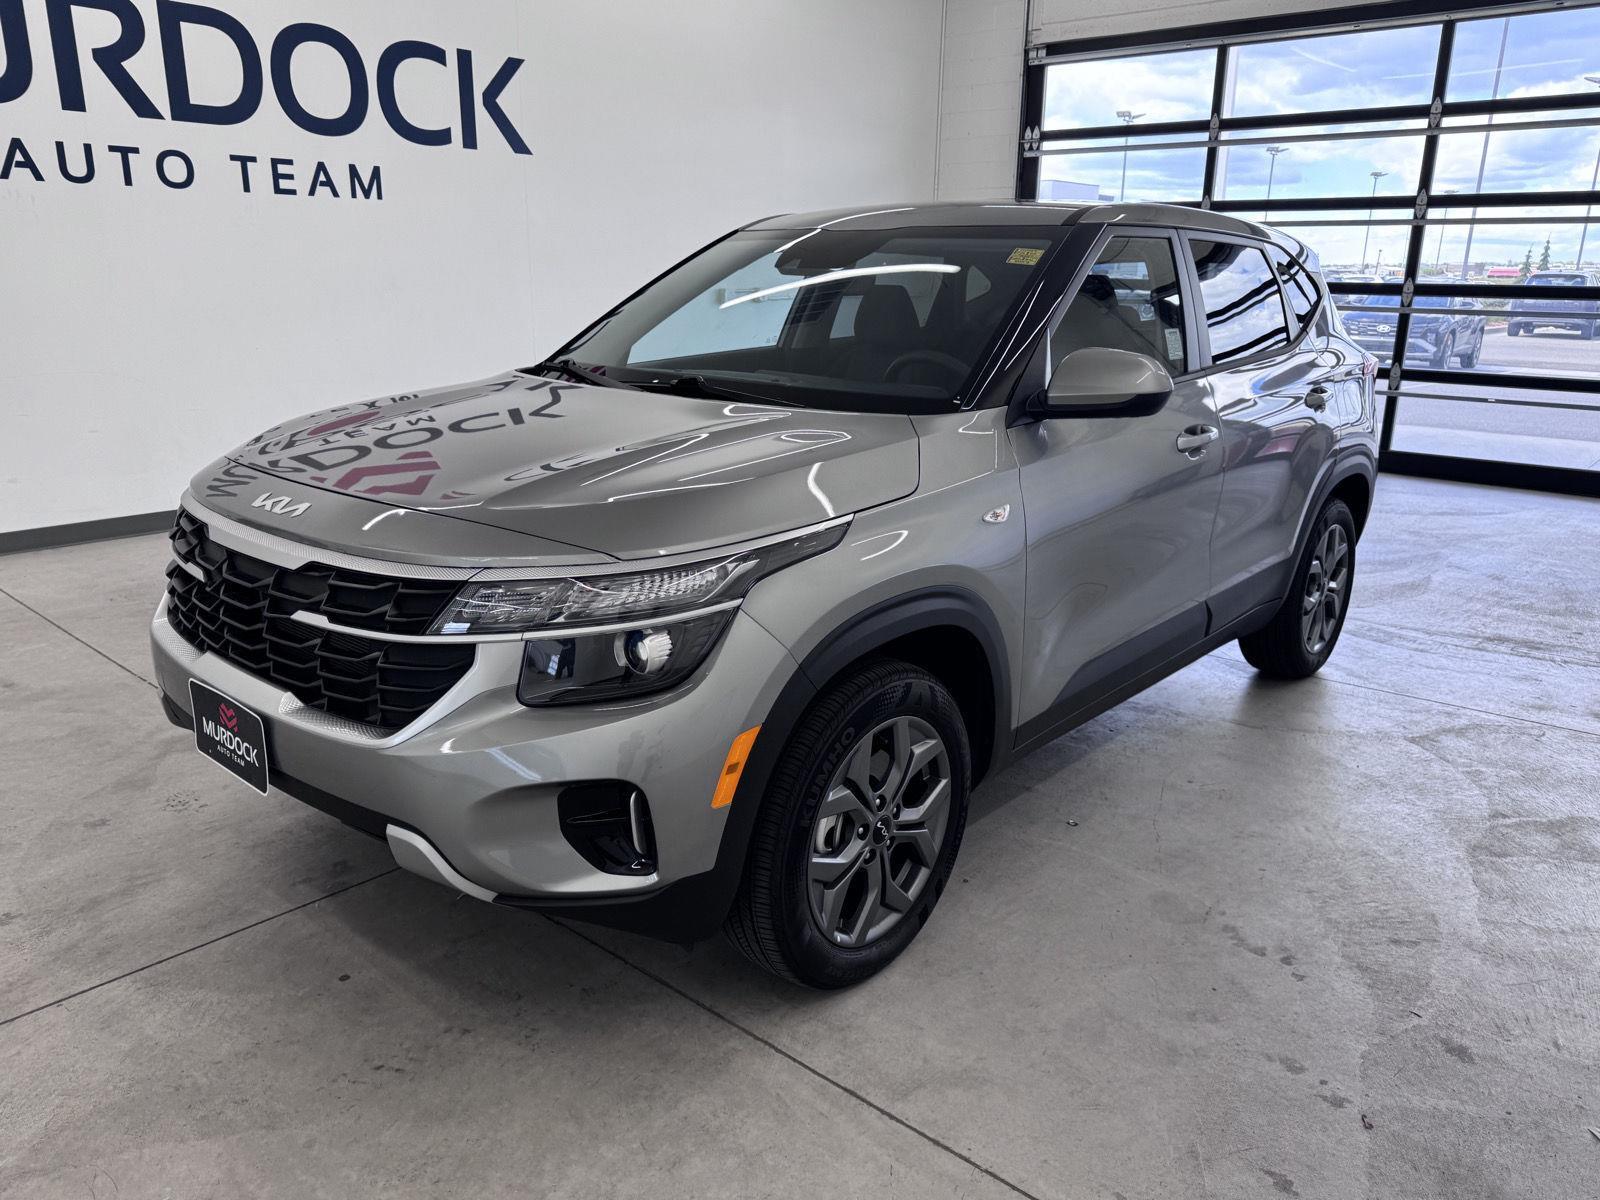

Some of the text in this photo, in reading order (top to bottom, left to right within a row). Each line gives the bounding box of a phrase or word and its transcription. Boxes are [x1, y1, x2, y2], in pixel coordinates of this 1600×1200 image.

[0, 137, 384, 200] AUTO TEAM
[251, 490, 312, 518] KIA
[202, 716, 259, 767] MURDOCK
[217, 745, 245, 767] AUTO TEAM
